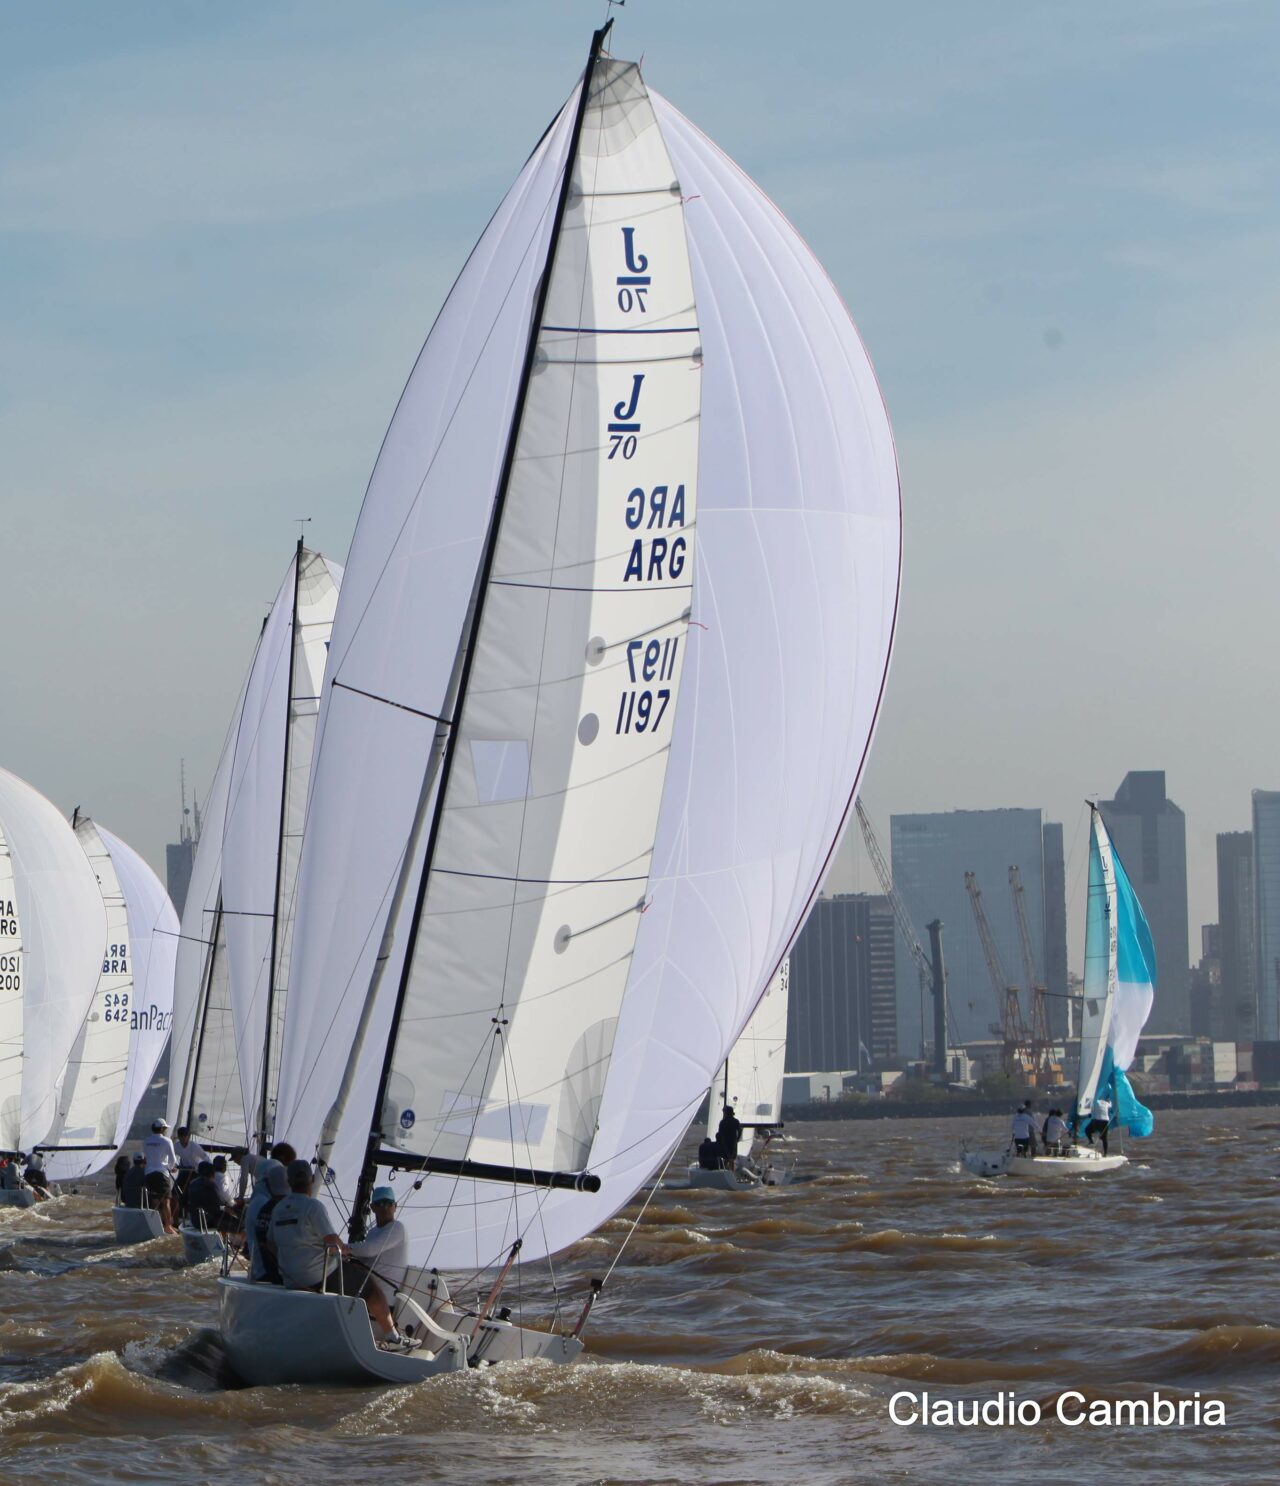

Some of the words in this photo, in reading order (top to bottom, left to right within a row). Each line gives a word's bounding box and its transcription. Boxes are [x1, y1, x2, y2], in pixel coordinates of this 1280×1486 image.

[614, 374, 646, 421] J
[607, 435, 638, 460] 70
[623, 537, 686, 582] ARG
[615, 690, 671, 736] 1197
[102, 960, 127, 973] BRA
[105, 1008, 129, 1022] 642
